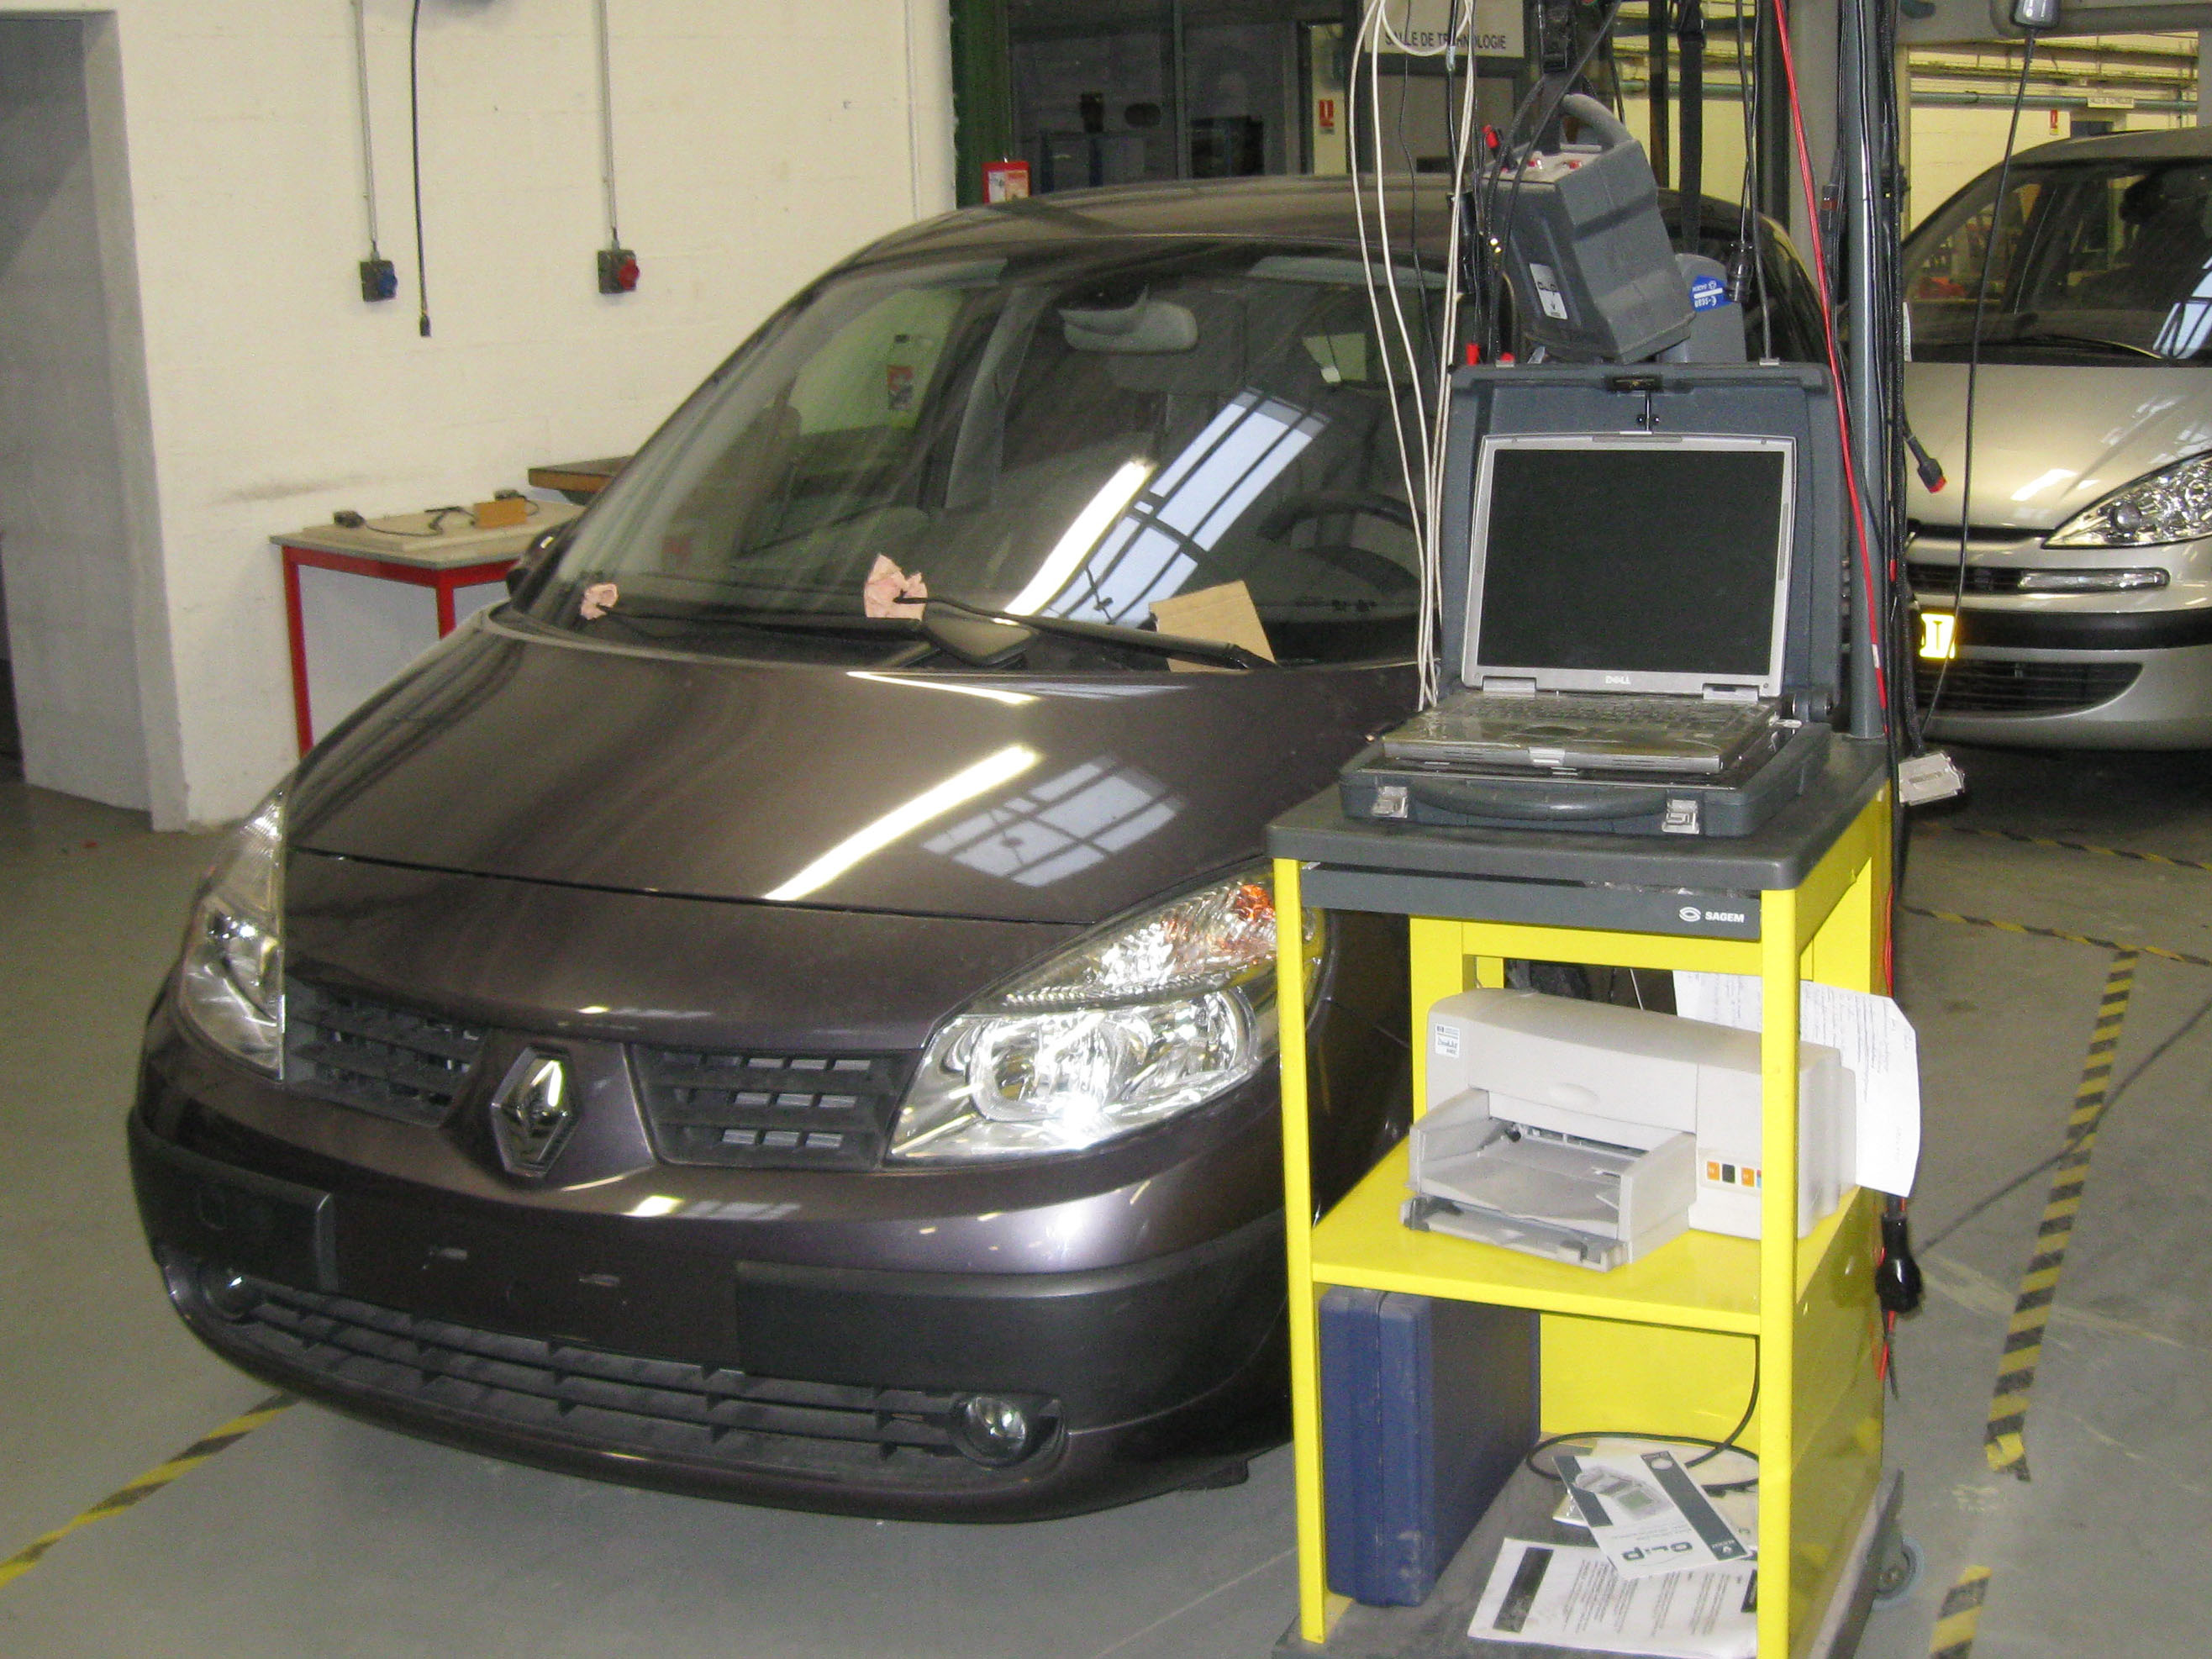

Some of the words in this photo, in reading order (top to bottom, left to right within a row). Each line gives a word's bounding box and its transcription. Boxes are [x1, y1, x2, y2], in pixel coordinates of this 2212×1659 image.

[1420, 32, 1434, 47] DE
[1605, 675, 1630, 685] DELL
[1704, 911, 1745, 923] SAGEM
